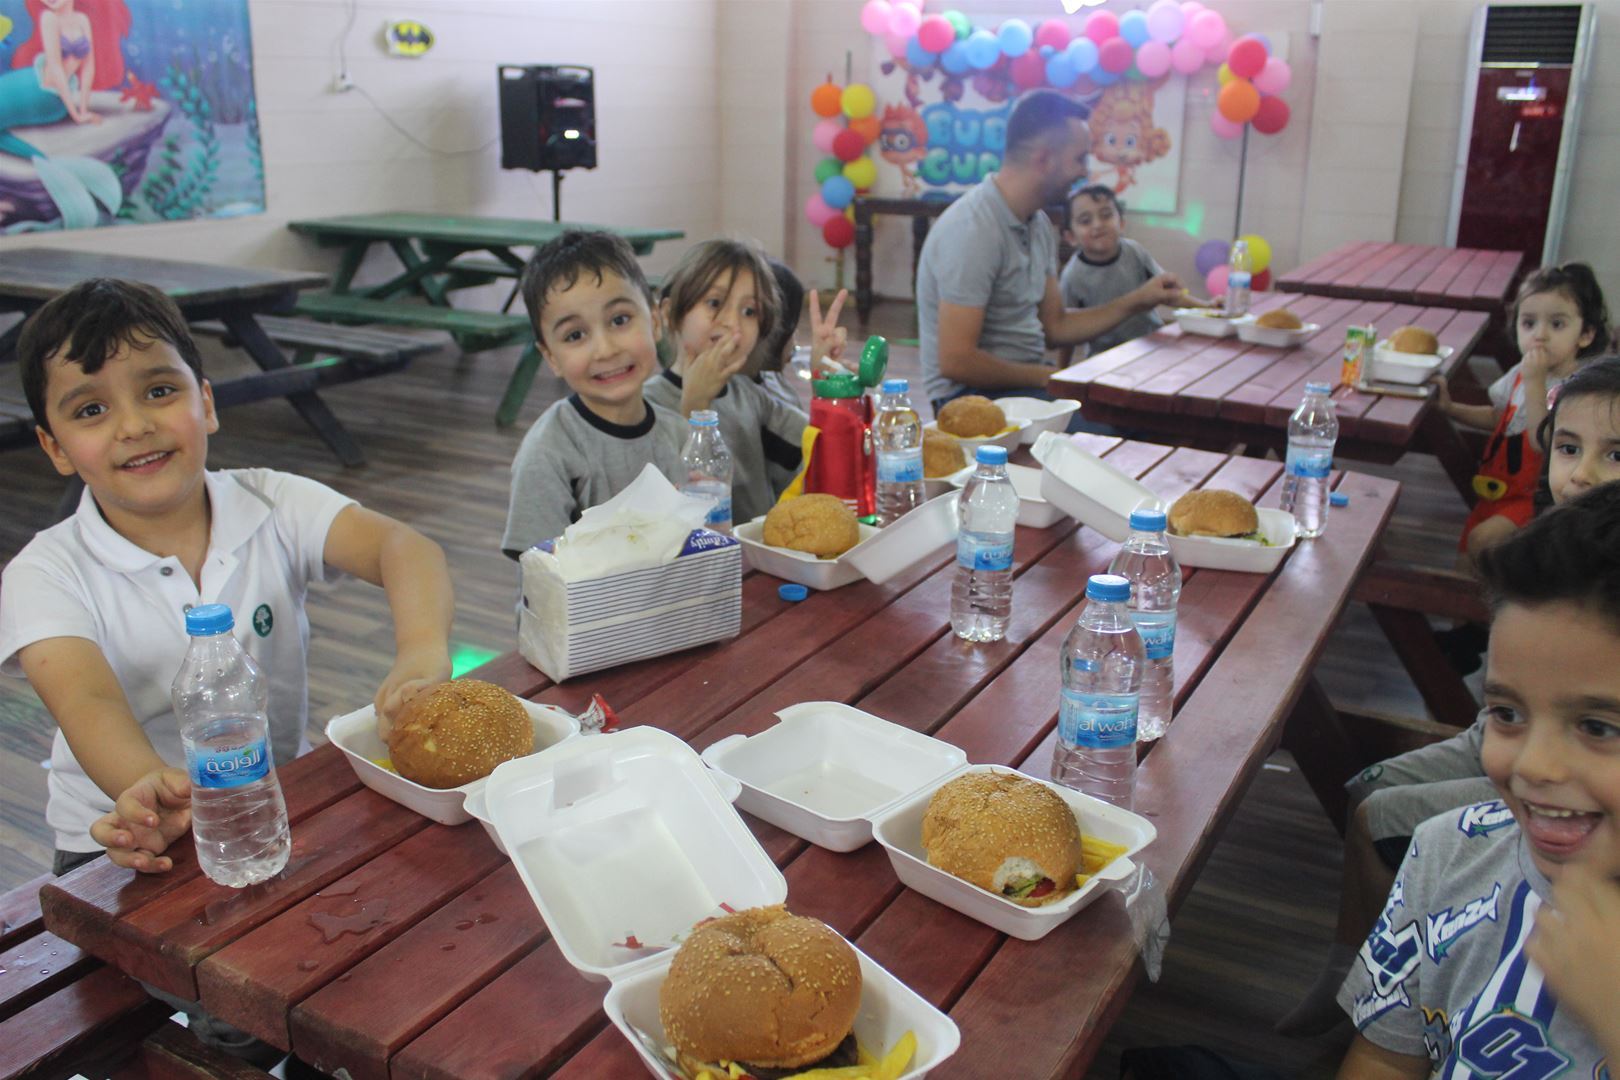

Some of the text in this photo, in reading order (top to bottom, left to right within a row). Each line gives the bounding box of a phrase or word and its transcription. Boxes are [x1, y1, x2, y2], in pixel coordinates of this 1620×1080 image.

[925, 110, 1007, 149] BUB
[923, 147, 1001, 181] GUP
[1079, 715, 1136, 732] al wah
[206, 748, 260, 773] الواحة
